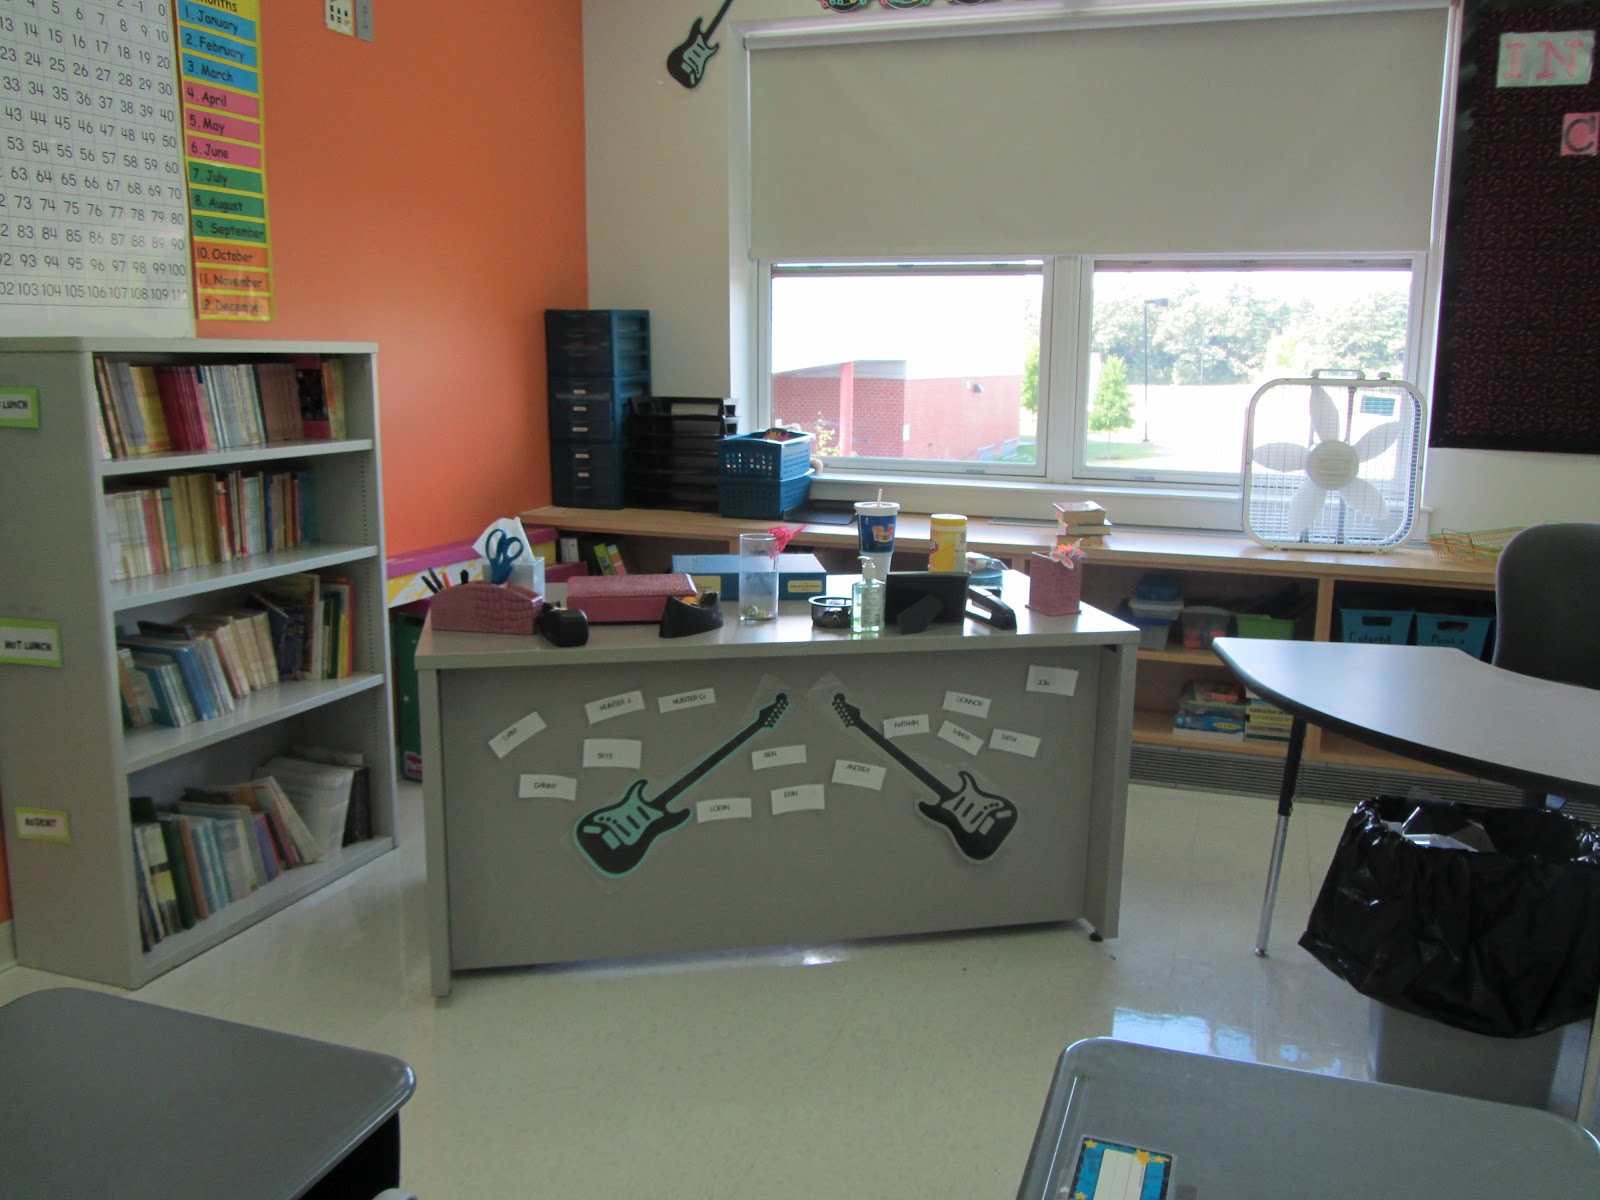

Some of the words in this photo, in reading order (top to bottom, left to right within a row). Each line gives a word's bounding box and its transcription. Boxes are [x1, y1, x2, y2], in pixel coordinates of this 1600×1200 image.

[158, 4, 165, 16] 0
[203, 0, 237, 12] onths
[52, 1, 60, 14] 5
[76, 8, 83, 20] 6
[97, 13, 104, 25] 7
[120, 20, 127, 32] 8
[141, 25, 147, 37] 9
[157, 29, 168, 42] 10
[185, 6, 194, 20] 1.
[198, 10, 238, 35] January
[0, 16, 14, 32] 13
[24, 22, 38, 37] 14
[49, 29, 62, 43] 15
[73, 34, 86, 48] 16
[96, 40, 108, 53] 17
[118, 45, 130, 59] 18
[140, 51, 150, 63] 19
[157, 56, 170, 69] 20
[185, 33, 197, 47] 2.
[200, 36, 244, 63] February
[1503, 40, 1585, 79] IN
[0, 46, 17, 62] 23
[25, 52, 41, 66] 24
[50, 58, 65, 72] 25
[73, 63, 88, 77] 26
[96, 68, 111, 82] 27
[118, 73, 132, 87] 28
[139, 78, 151, 91] 29
[159, 82, 172, 95] 30
[188, 60, 198, 74] 3.
[201, 64, 233, 82] March
[3, 76, 20, 92] 33
[29, 82, 44, 96] 34
[53, 87, 68, 101] 35
[76, 92, 91, 105] 36
[99, 96, 112, 110] 37
[120, 100, 133, 114] 38
[140, 105, 152, 118] 39
[160, 109, 174, 122] 40
[188, 86, 198, 100] 4.
[202, 92, 227, 108] April
[6, 106, 22, 121] 43
[30, 111, 47, 125] 44
[55, 115, 70, 130] 45
[78, 120, 93, 134] 46
[100, 124, 114, 137] 47
[121, 128, 135, 141] 48
[142, 132, 155, 144] 49
[162, 136, 176, 148] 50
[190, 114, 200, 128] 5.
[203, 118, 224, 134] May
[1564, 115, 1596, 152] C
[8, 136, 24, 151] 53
[32, 141, 48, 154] 54
[57, 145, 72, 158] 55
[80, 148, 95, 162] 56
[102, 152, 116, 164] 57
[124, 155, 138, 168] 58
[145, 159, 157, 171] 59
[166, 162, 178, 174] 60
[192, 142, 202, 154] 6.
[205, 144, 228, 159] June
[11, 166, 28, 181] 63
[37, 170, 52, 183] 64
[61, 173, 77, 186] 65
[85, 177, 99, 189] 66
[107, 179, 120, 192] 67
[128, 182, 142, 194] 68
[149, 185, 161, 197] 69
[168, 188, 181, 199] 70
[193, 168, 203, 180] 7.
[206, 170, 227, 188] July
[14, 196, 32, 210] 73
[40, 199, 56, 212] 74
[64, 201, 79, 214] 75
[87, 204, 102, 217] 76
[109, 206, 123, 219] 77
[131, 209, 144, 221] 78
[152, 211, 164, 222] 79
[171, 213, 183, 225] 80
[195, 195, 205, 206] 8.
[210, 198, 243, 213] August
[18, 225, 34, 239] 83
[42, 227, 58, 240] 84
[66, 229, 81, 242] 85
[111, 234, 124, 246] 87
[172, 239, 184, 251] 90
[196, 220, 207, 232] 9.
[211, 223, 264, 238] September
[20, 254, 37, 268] 93
[44, 256, 59, 268] 94
[68, 257, 83, 270] 95
[112, 260, 126, 272] 97
[153, 263, 165, 273] 99
[169, 264, 185, 276] 100
[212, 248, 252, 262] October
[0, 282, 14, 296] 02
[18, 283, 38, 296] 103
[42, 284, 61, 297] 104
[65, 285, 85, 298] 105
[88, 286, 107, 299] 106
[152, 289, 168, 300] 109
[214, 274, 262, 288] November
[216, 300, 264, 312] December
[3, 400, 28, 410] LUNCH
[5, 641, 22, 649] HOT
[25, 641, 52, 652] LUNCH
[600, 699, 626, 712] HUNTER
[672, 695, 697, 705] HUNTER
[956, 696, 983, 707] CONNOR
[894, 719, 919, 728] NATHAN
[845, 764, 870, 773] ANDREA
[784, 790, 799, 798] ERIN
